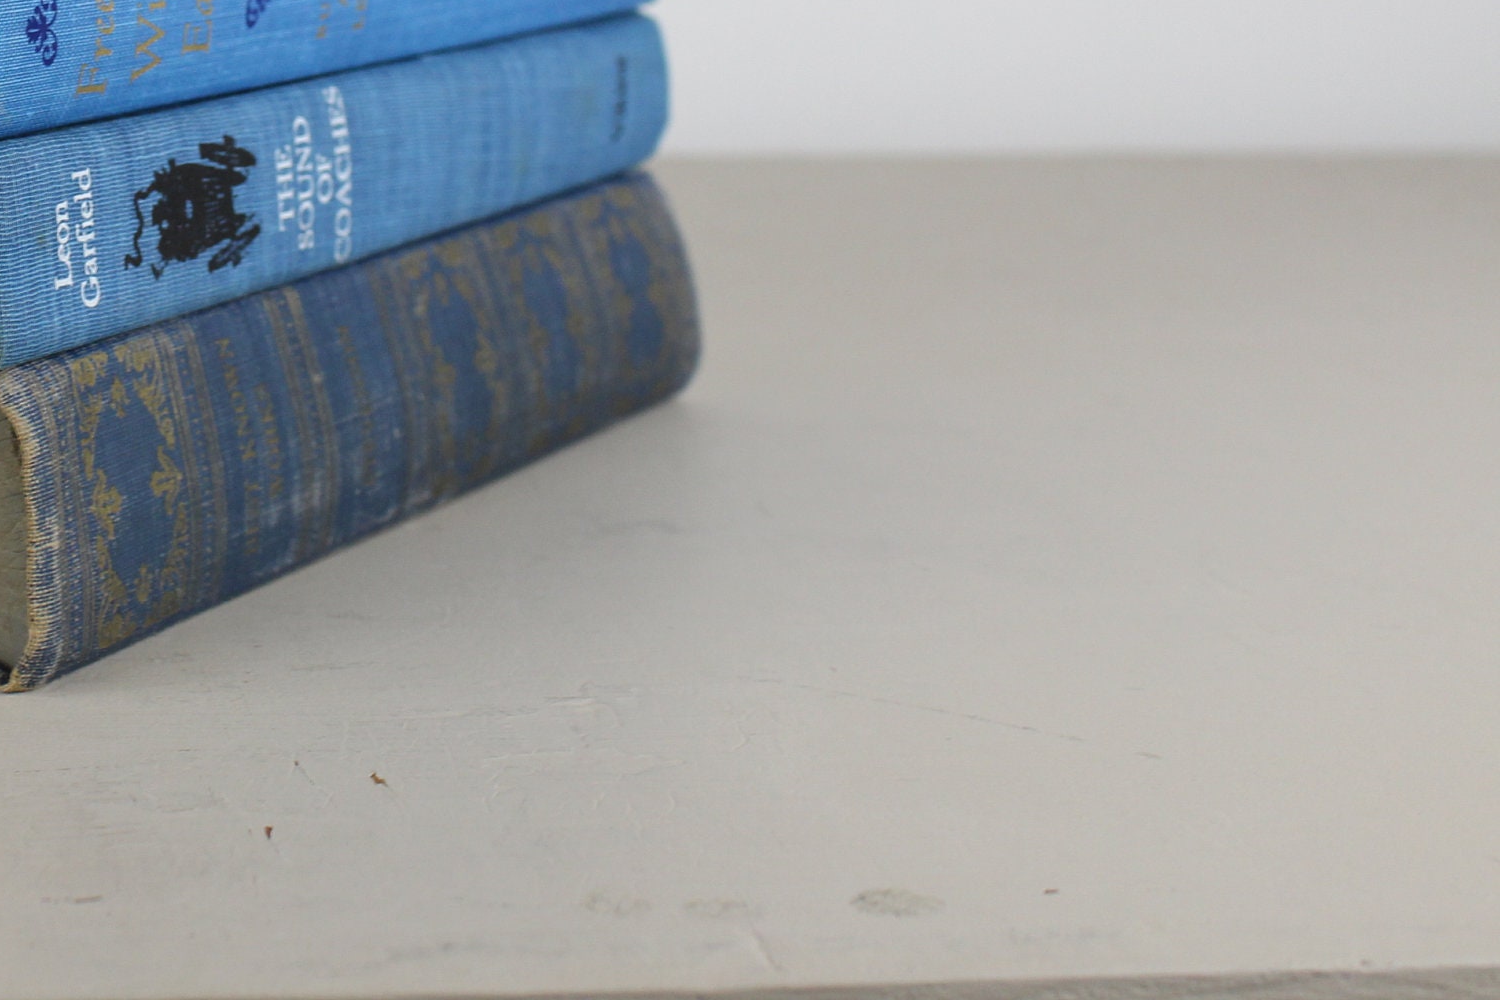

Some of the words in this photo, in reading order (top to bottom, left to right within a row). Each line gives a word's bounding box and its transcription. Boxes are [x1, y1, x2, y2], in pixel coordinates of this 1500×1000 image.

[275, 145, 297, 232] THE
[293, 115, 315, 250] SOUND
[316, 153, 334, 204] OF
[322, 86, 352, 264] COACHES
[55, 200, 74, 289] Leon
[71, 168, 101, 308] Garfield
